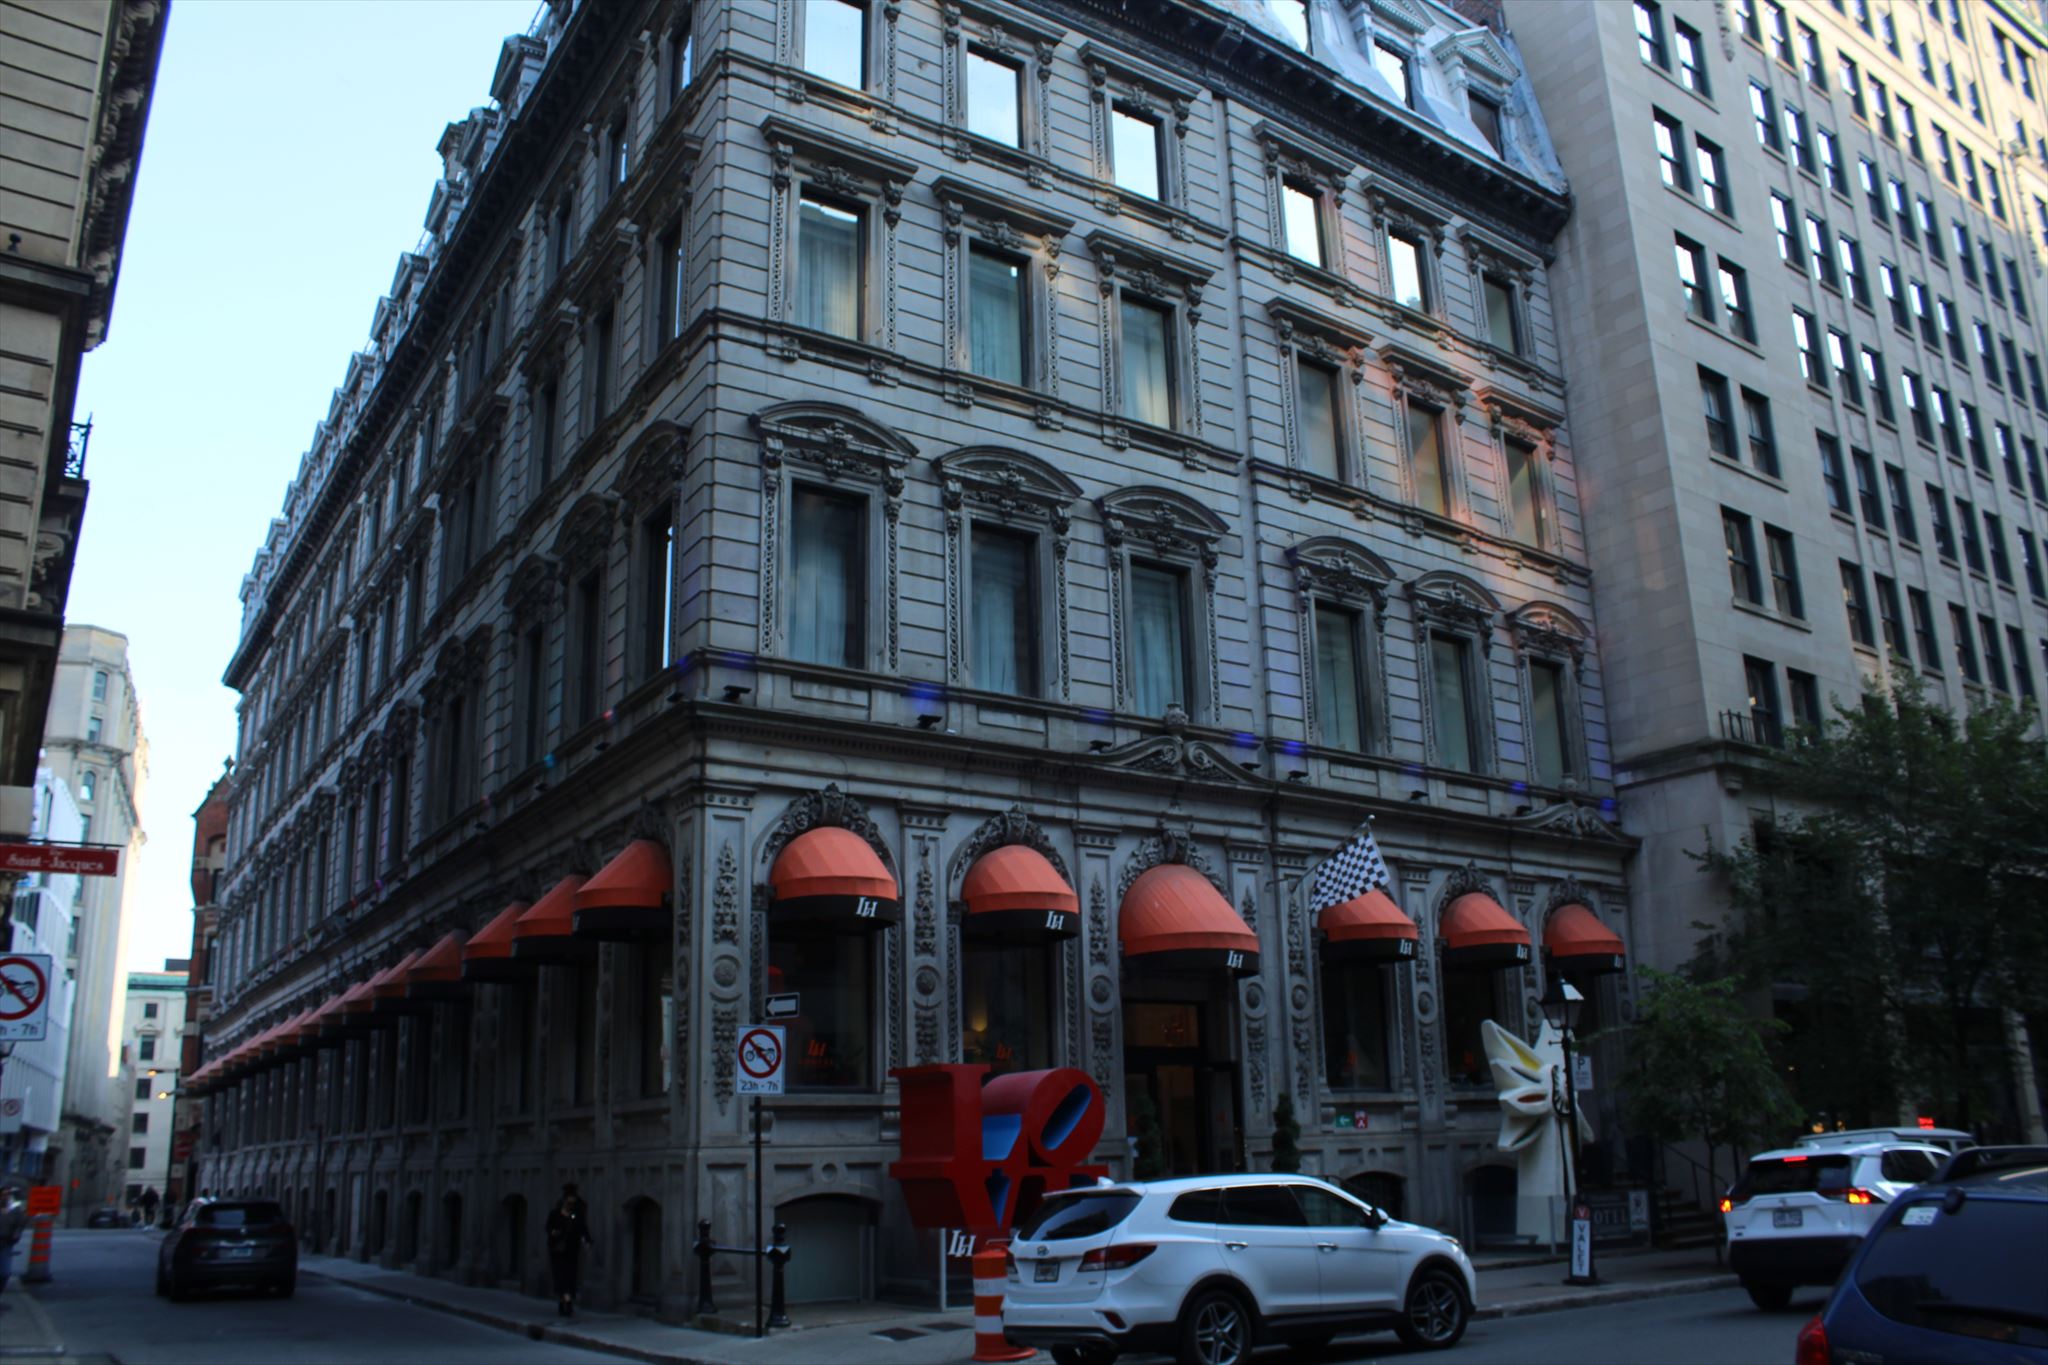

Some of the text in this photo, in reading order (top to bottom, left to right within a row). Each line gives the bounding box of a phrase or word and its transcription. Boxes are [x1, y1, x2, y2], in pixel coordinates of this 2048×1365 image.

[741, 1080, 759, 1091] 23h
[768, 1081, 778, 1091] 7h
[1577, 1224, 1586, 1272] VALET
